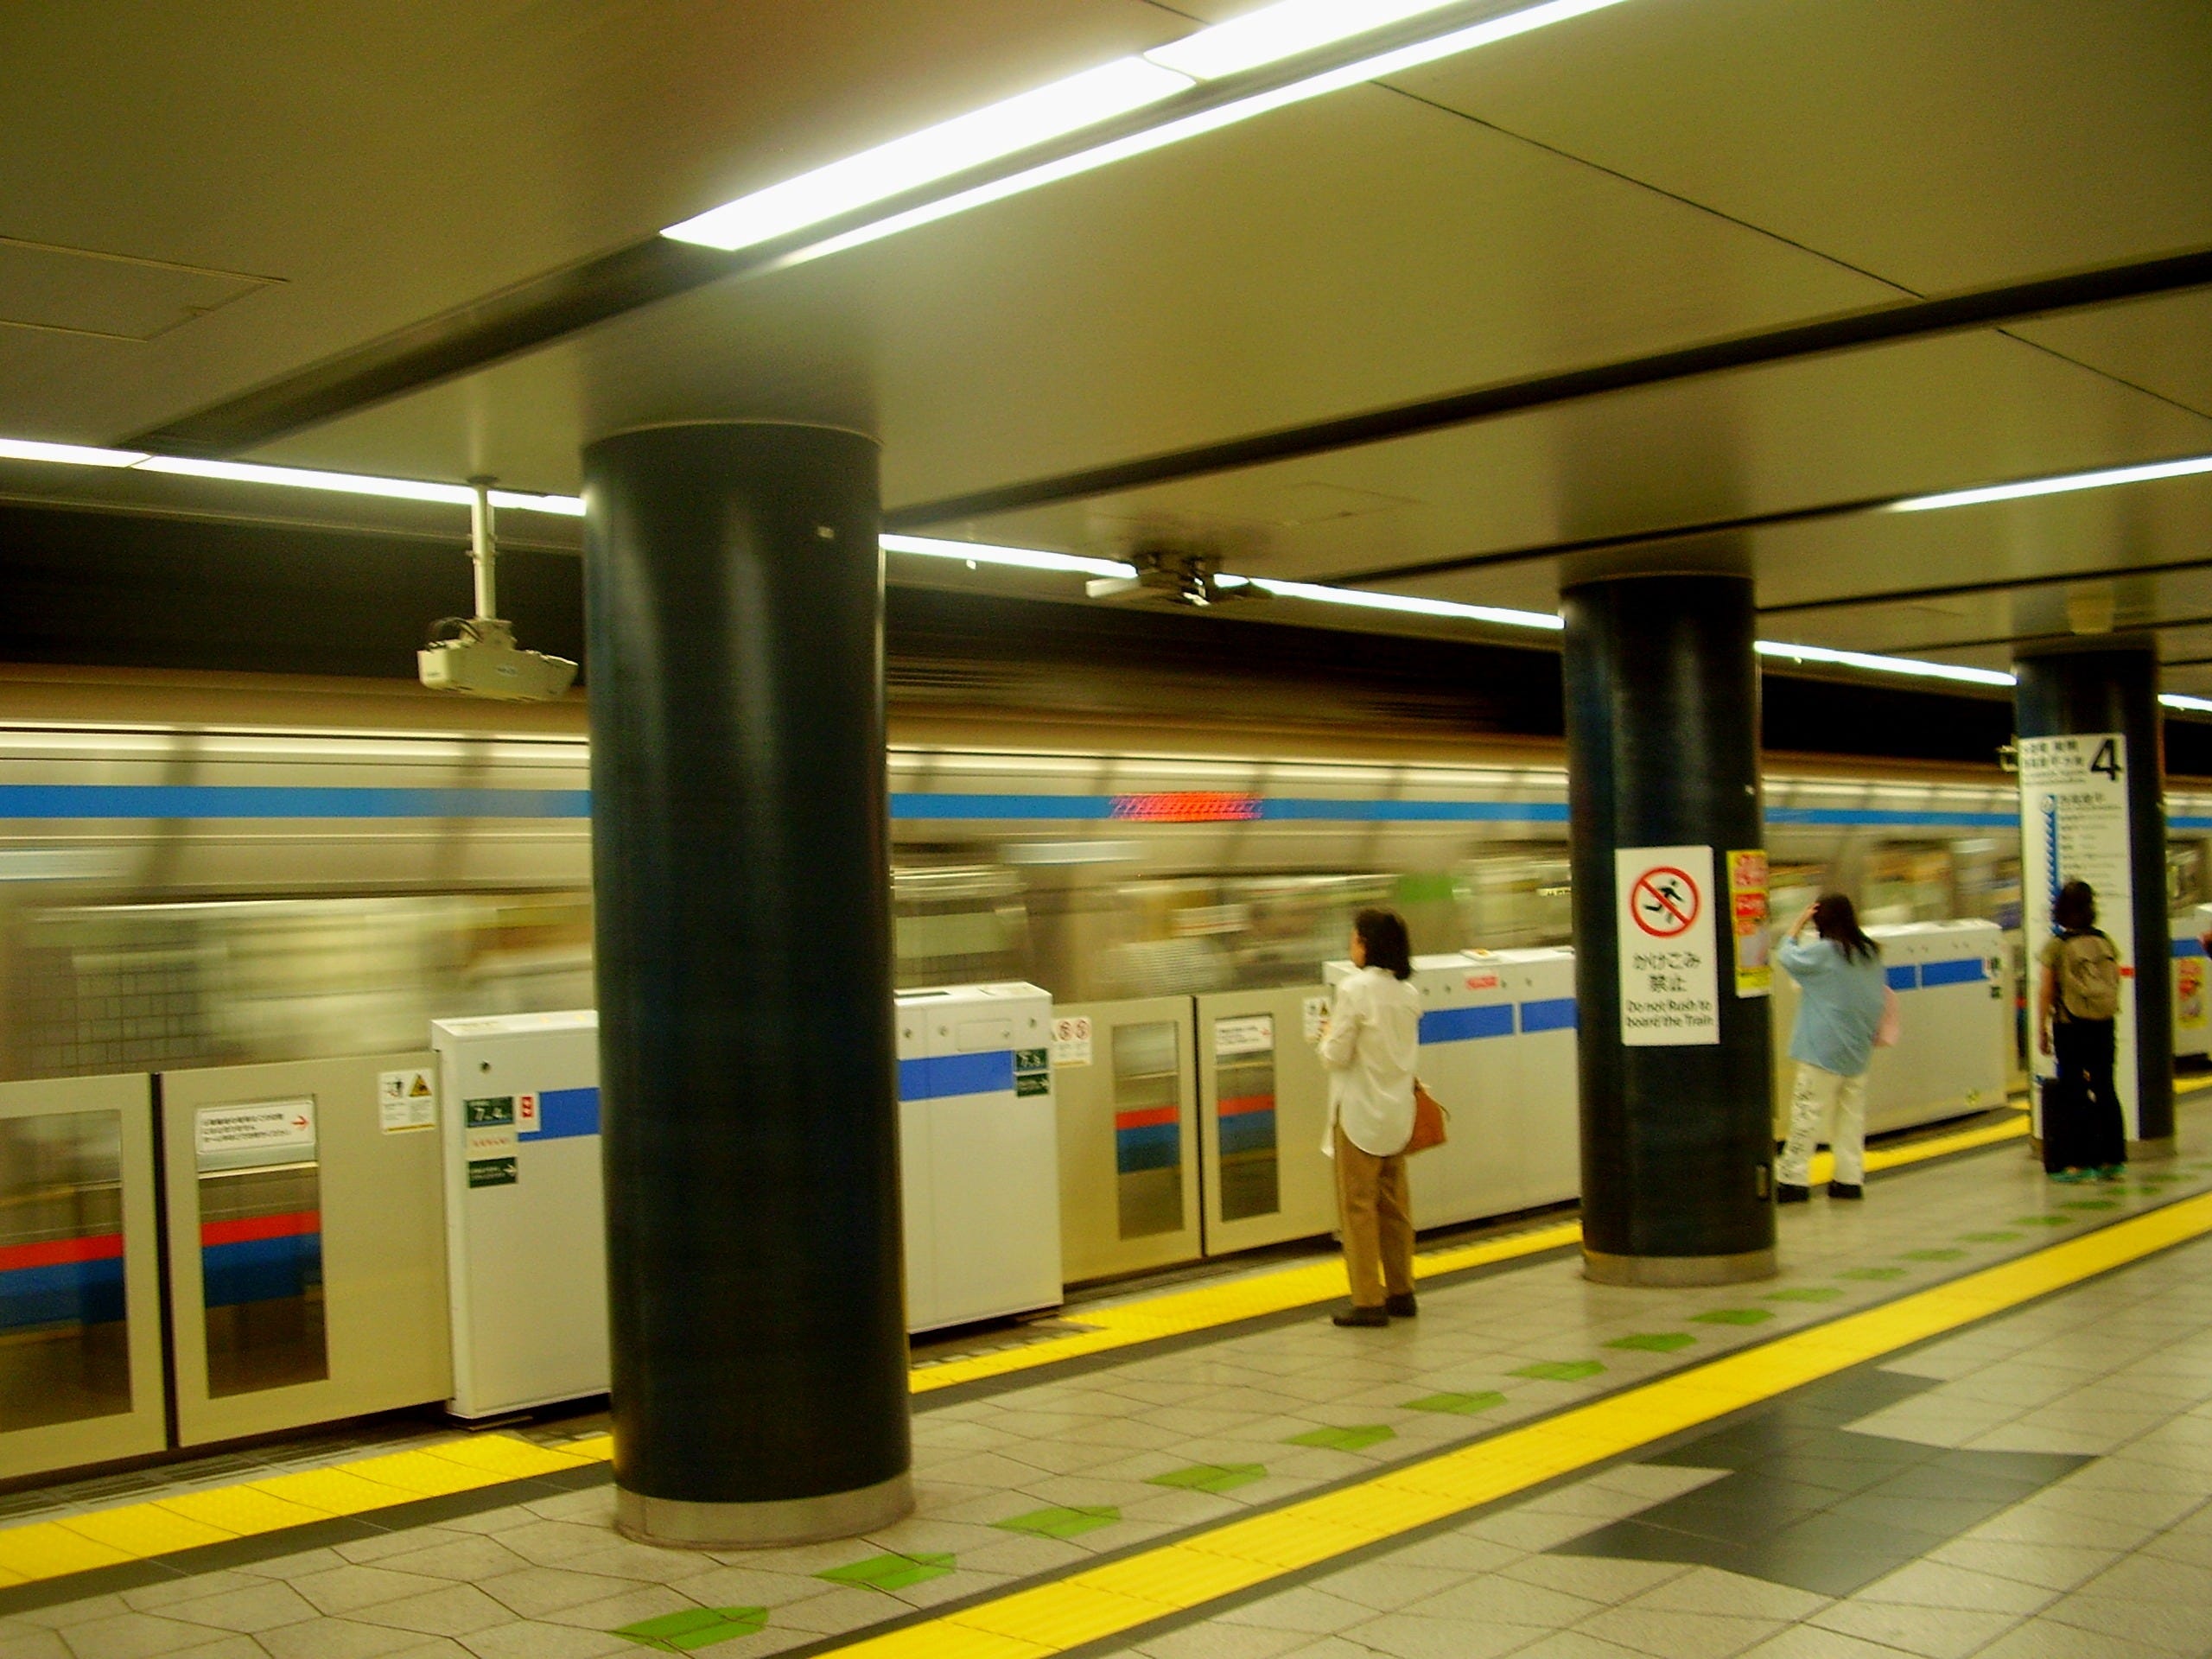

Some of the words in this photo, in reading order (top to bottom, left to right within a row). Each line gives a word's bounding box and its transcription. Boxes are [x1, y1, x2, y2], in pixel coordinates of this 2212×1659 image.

[2090, 739, 2122, 781] 4
[1632, 951, 1702, 970] かけこみ
[1649, 974, 1687, 993] 禁止
[1627, 1000, 1644, 1012] Do
[1647, 1000, 1665, 1012] not
[1669, 999, 1697, 1012] Rush
[1700, 999, 1712, 1011] to
[1626, 1015, 1661, 1028] board
[1663, 1014, 1681, 1027] the
[1684, 1014, 1714, 1027] Train
